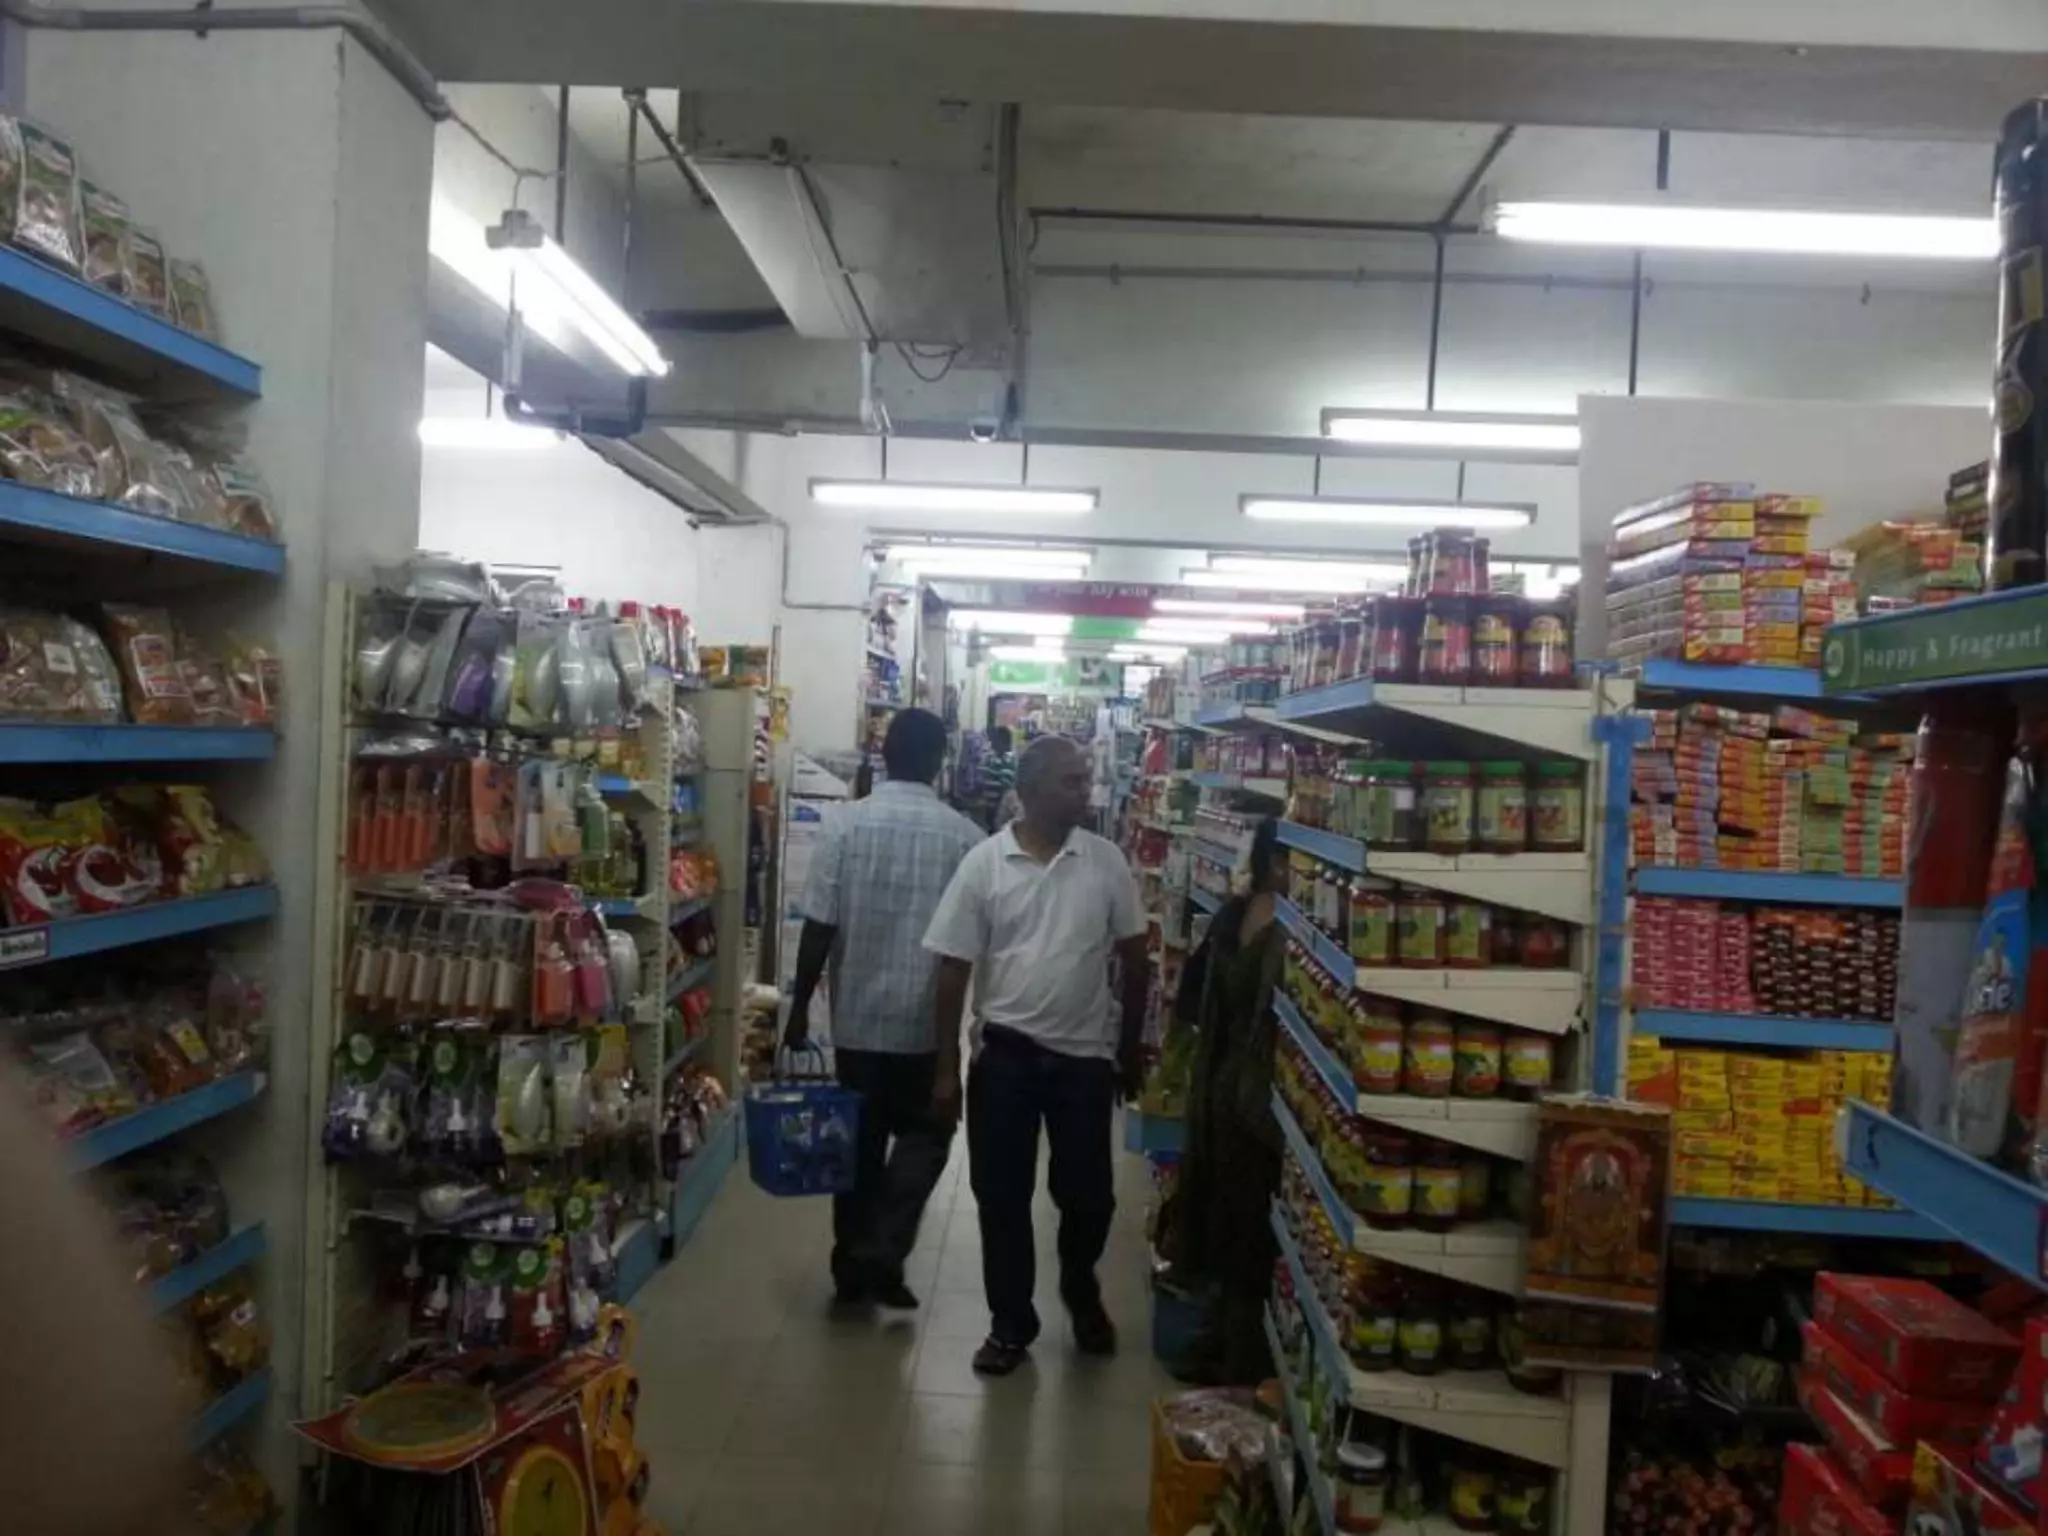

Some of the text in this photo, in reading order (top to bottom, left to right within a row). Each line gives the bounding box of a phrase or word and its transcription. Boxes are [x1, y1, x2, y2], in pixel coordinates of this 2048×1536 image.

[1863, 625, 2041, 669] Happy & Fragrant
